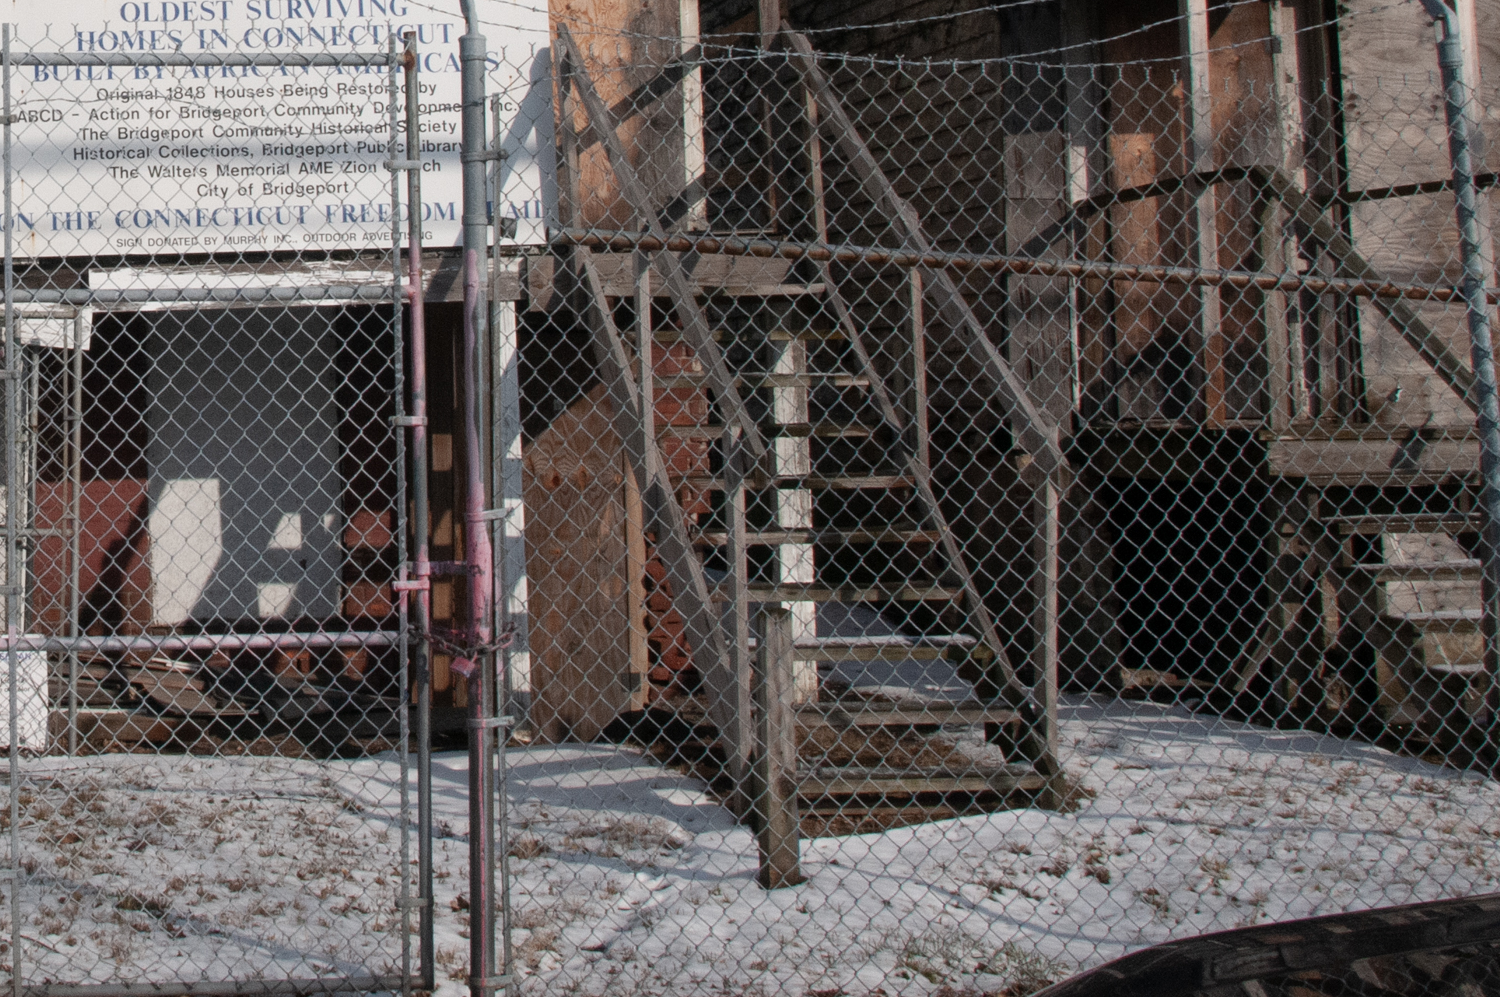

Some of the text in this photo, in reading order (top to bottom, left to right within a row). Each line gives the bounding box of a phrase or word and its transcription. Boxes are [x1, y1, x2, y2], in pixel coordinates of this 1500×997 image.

[120, 0, 233, 23] OLDEST
[77, 30, 183, 52] HOMES
[198, 27, 230, 50] IN
[33, 64, 166, 82] BUILT BY
[96, 87, 158, 103] Original
[166, 86, 206, 100] 1848
[214, 85, 275, 99] Houses
[283, 83, 329, 98] Being
[419, 81, 437, 96] by
[16, 103, 364, 123] ABCD Action for Bridgeport Community
[80, 119, 457, 143] The Bridgeport Community Historical Sciety
[73, 140, 463, 160] Historical Collections, Bridgeport Publc ibrary
[110, 166, 140, 179] The
[147, 165, 208, 178] Walters
[216, 163, 290, 177] Memorial
[298, 161, 334, 175] AME
[342, 160, 377, 174] Zion
[197, 181, 349, 199] City of Bridgeport
[46, 211, 102, 232] THE
[114, 205, 310, 229] CONNECTICUT
[325, 201, 456, 224] FREEDOM
[116, 233, 357, 247] SIGN DONATED BY MURPHY OUTDOOR
